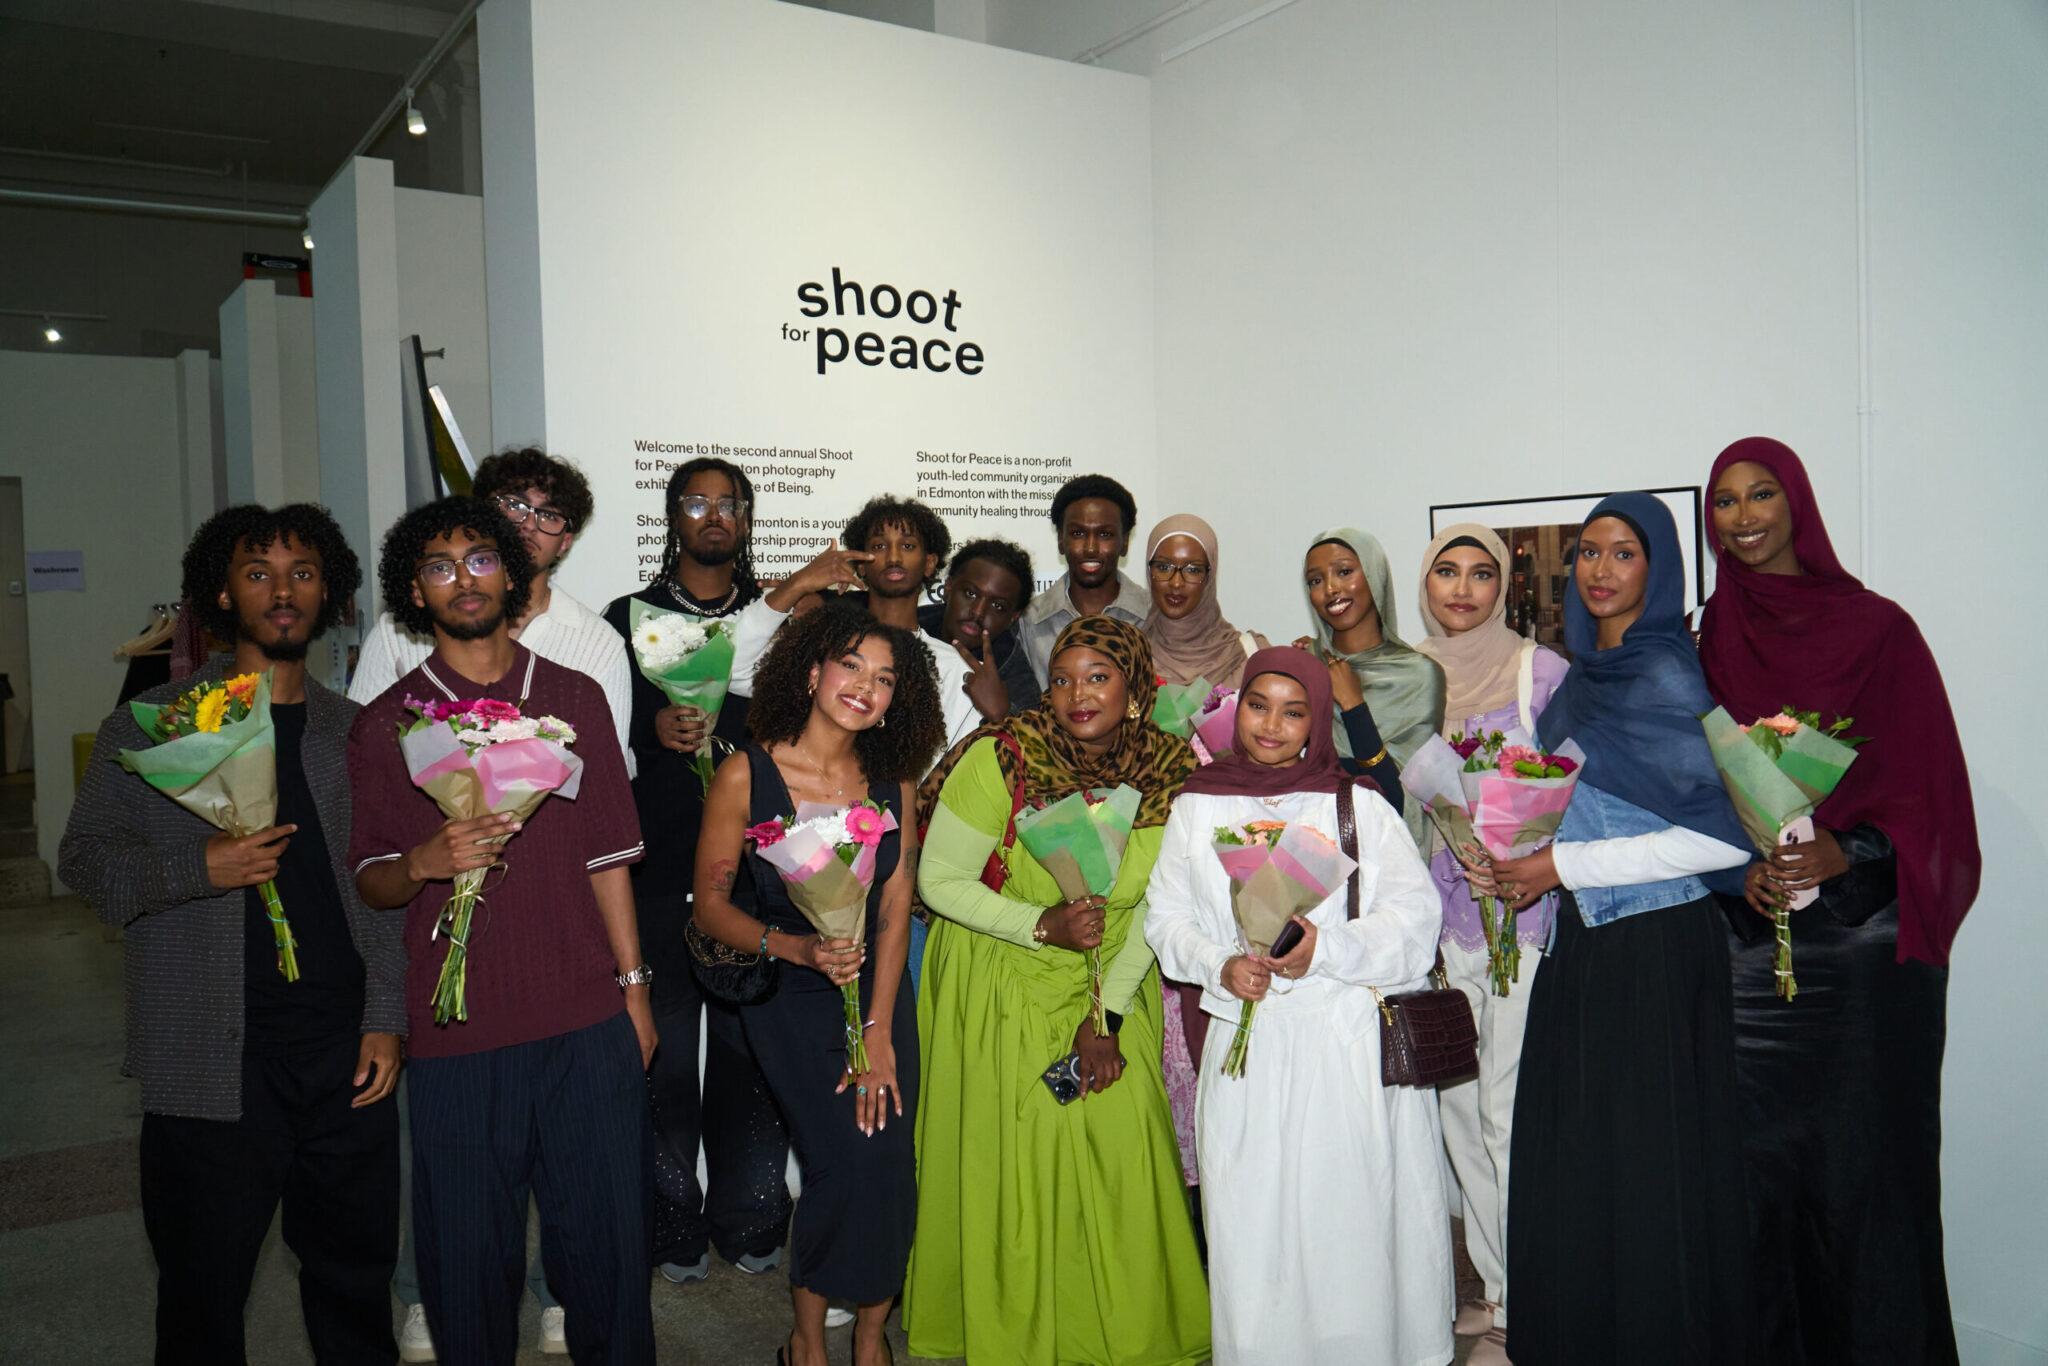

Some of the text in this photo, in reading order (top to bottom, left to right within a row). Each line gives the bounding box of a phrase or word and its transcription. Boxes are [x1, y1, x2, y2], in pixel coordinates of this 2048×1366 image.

[797, 267, 962, 332] shoot
[782, 323, 984, 375] for peace
[635, 440, 853, 461] Welcome to the second annual Shoot
[635, 459, 652, 471] for
[656, 460, 680, 472] Pea
[763, 464, 835, 479] photography
[917, 451, 1072, 469] Shoot for Peace is a non-profit
[636, 478, 668, 490] exhib
[764, 482, 775, 492] of
[778, 482, 813, 496] Being.
[917, 470, 1079, 486] youth-led community organiza
[918, 487, 1056, 500] in Edmonton with the missi
[932, 505, 1052, 519] mmunity healing throug
[636, 513, 849, 531] Shoo monton is a yout
[751, 534, 787, 548] orship
[766, 552, 820, 563] commun
[762, 569, 792, 580] creat
